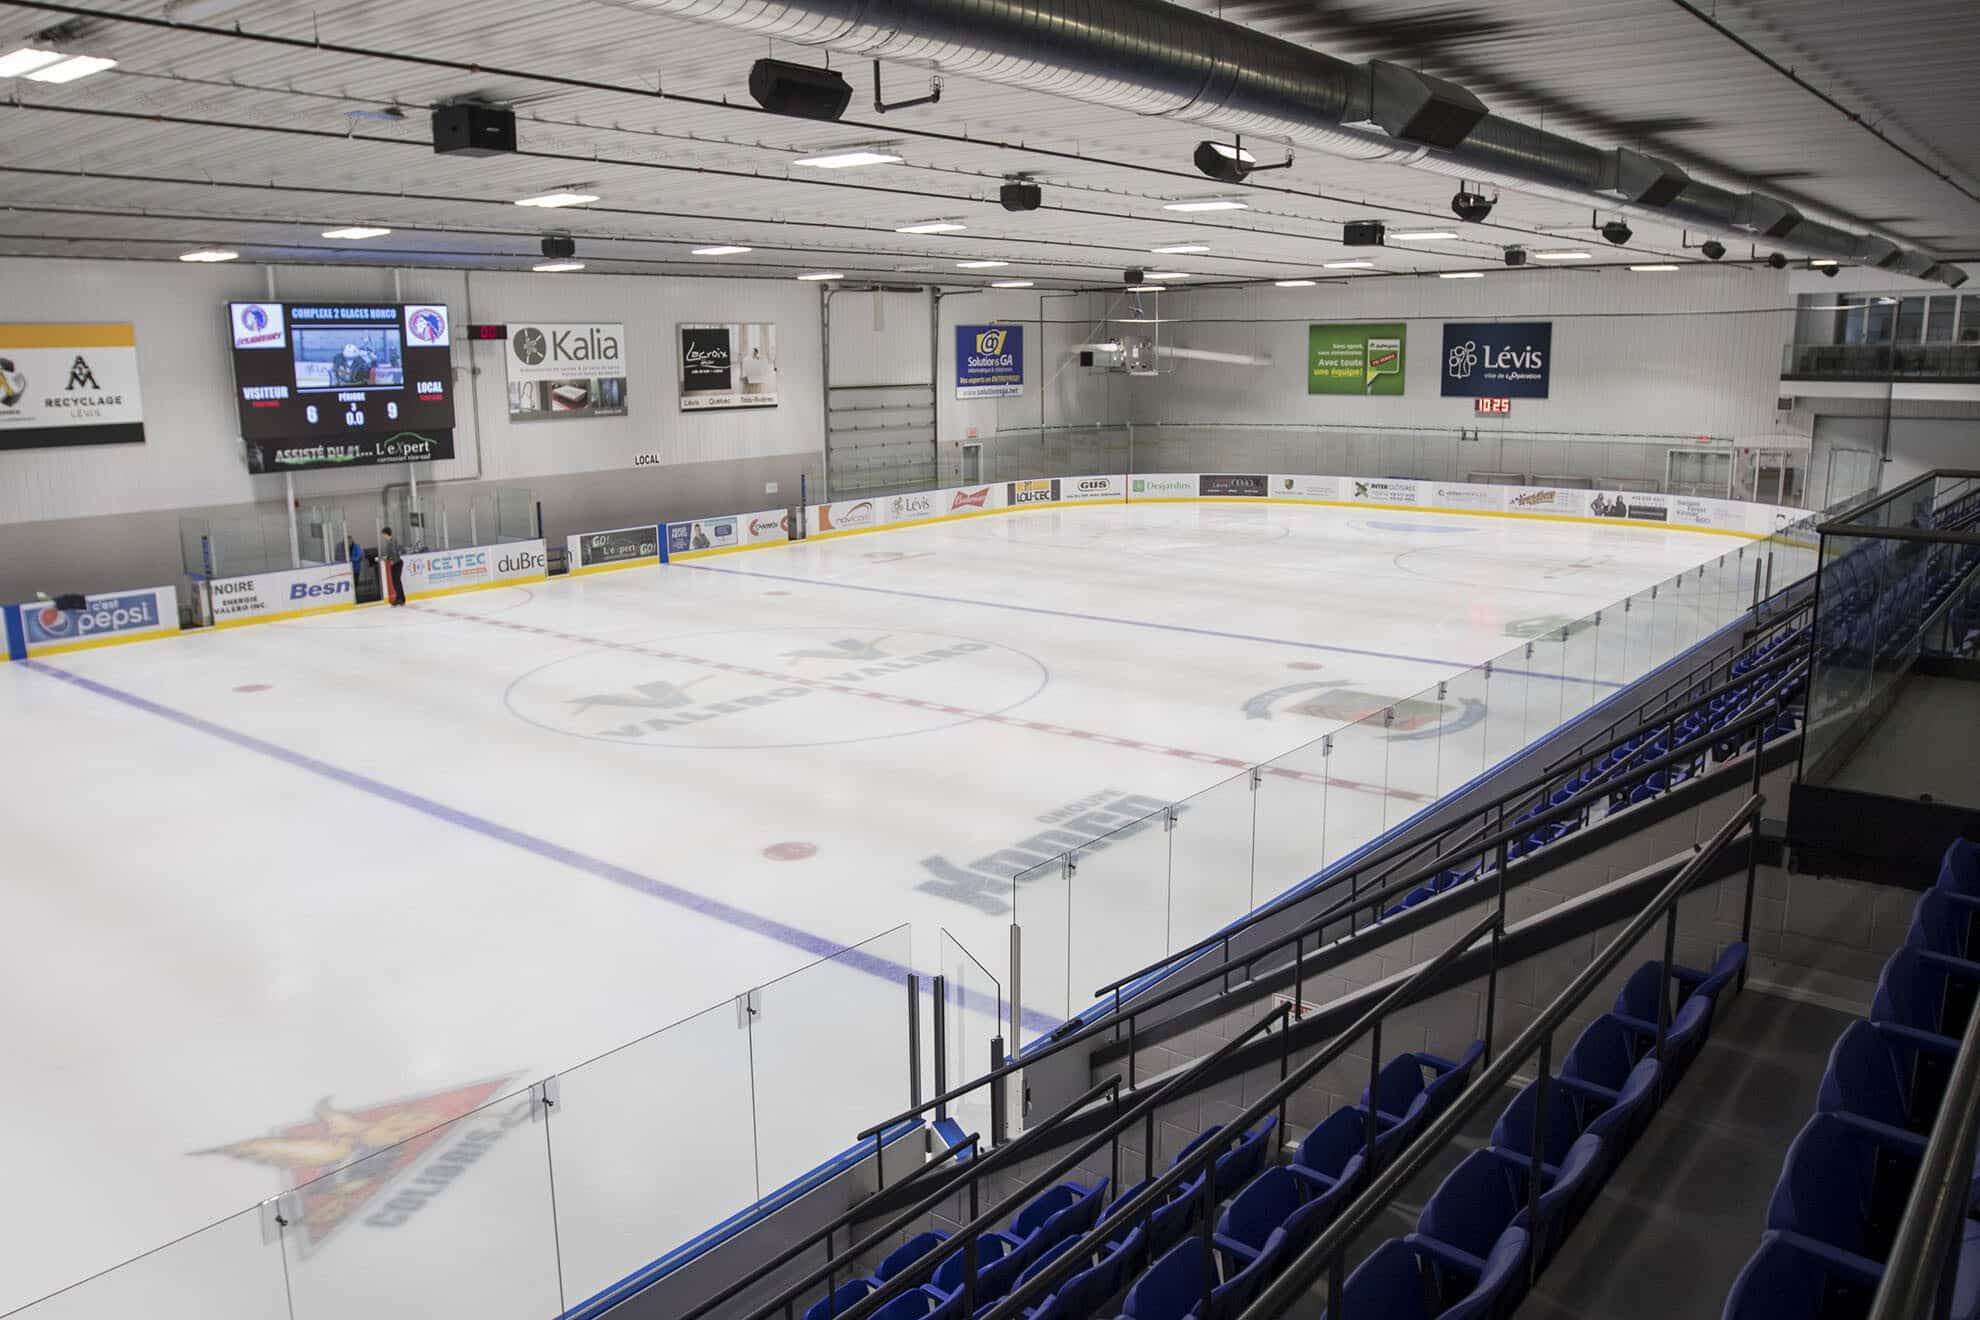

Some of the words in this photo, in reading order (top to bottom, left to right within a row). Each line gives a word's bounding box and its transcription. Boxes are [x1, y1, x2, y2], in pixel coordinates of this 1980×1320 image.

[292, 308, 333, 320] COMPLEXE
[334, 308, 340, 319] 2
[341, 308, 369, 319] GLACES
[370, 308, 397, 320] HONCO
[552, 328, 619, 361] Kalia
[686, 341, 728, 361] Lacroix
[968, 356, 999, 367] Solutions
[1000, 354, 1013, 366] GA
[1482, 345, 1542, 369] Lévis
[1331, 367, 1363, 377] équipe!
[243, 386, 289, 400] VISITEUR
[417, 382, 443, 394] LOCAL
[45, 396, 122, 408] RECYCLAGE
[306, 405, 318, 423] 6
[387, 402, 398, 419] 9
[345, 411, 364, 425] 0.0
[275, 445, 325, 463] ASSISTÉ
[327, 445, 345, 458] DU
[634, 454, 660, 465] LOCAL
[1080, 480, 1108, 489] GUS
[1147, 480, 1191, 491] Desjardins
[1016, 490, 1050, 502] LOU-TEC
[905, 496, 930, 512] Lévis
[592, 535, 610, 547] GO!
[639, 543, 657, 555] GO!
[214, 580, 255, 596] NOIRE
[78, 601, 152, 636] pepsi
[824, 642, 990, 682] VALERO
[597, 685, 812, 738] VALERO
